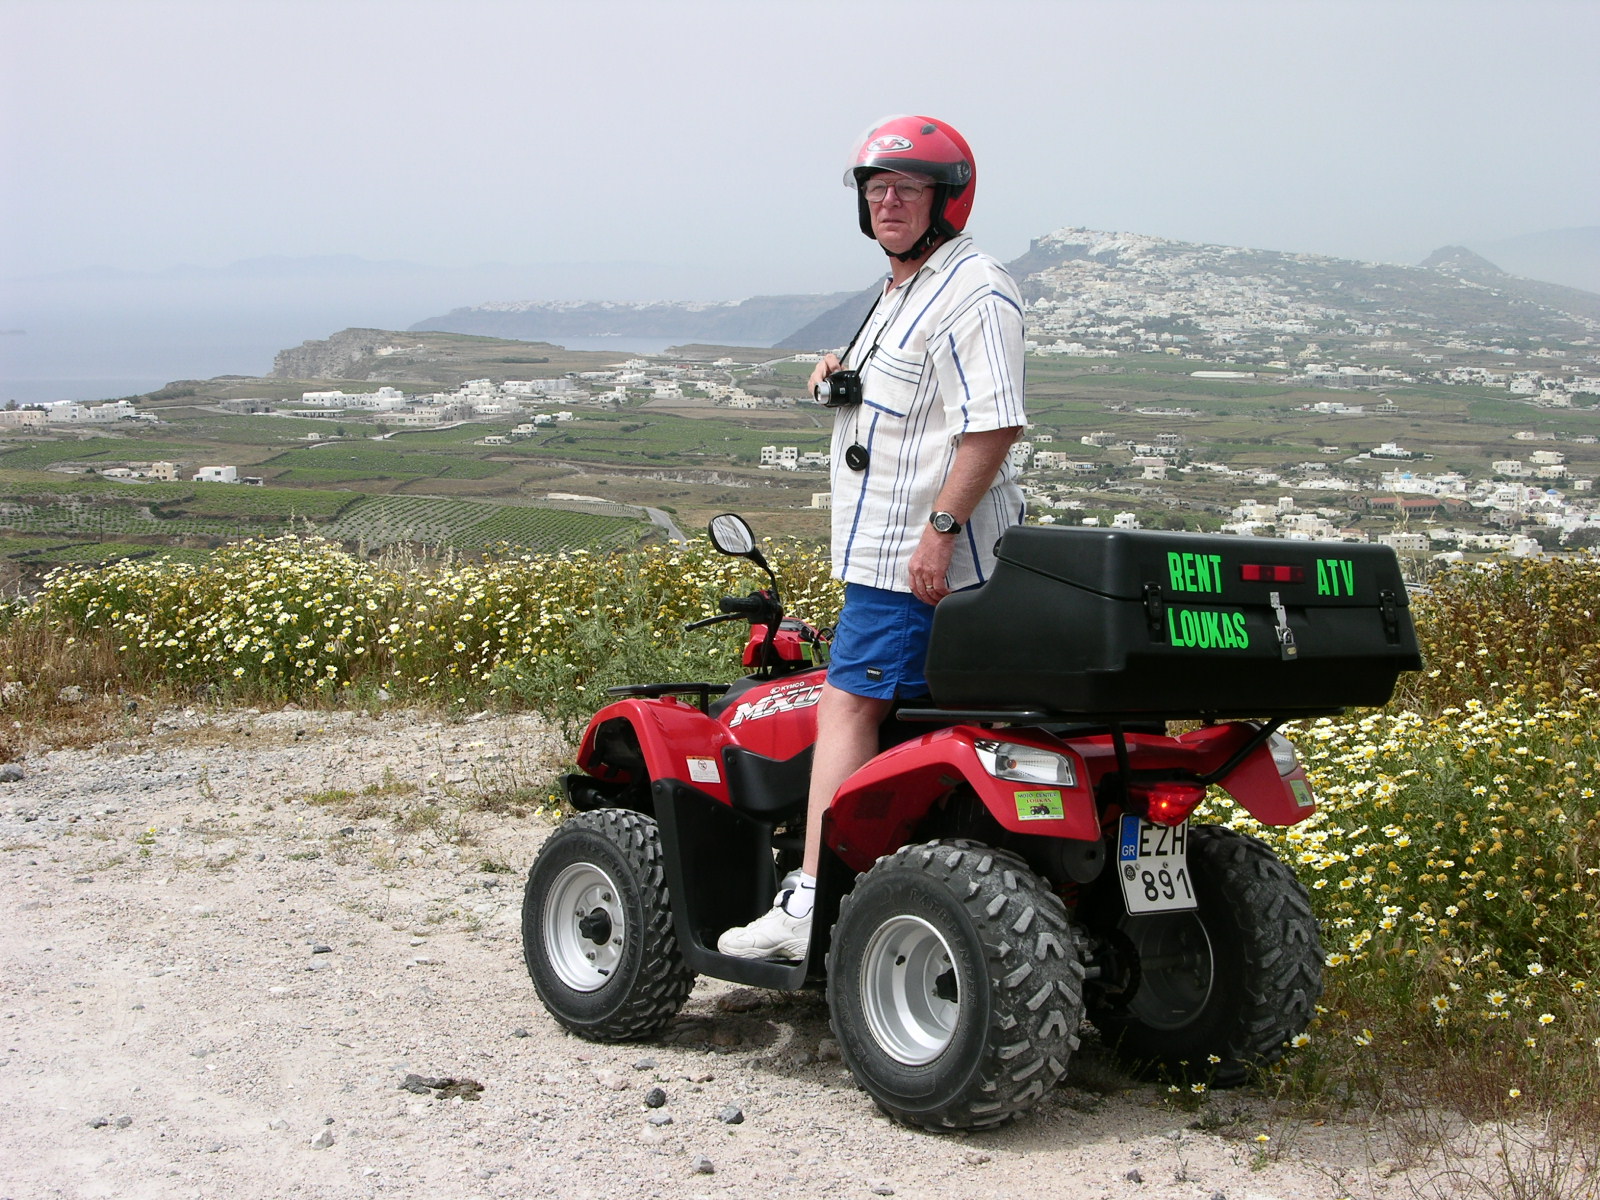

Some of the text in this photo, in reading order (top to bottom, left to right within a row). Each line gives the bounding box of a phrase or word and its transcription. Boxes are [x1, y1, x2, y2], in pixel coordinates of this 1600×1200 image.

[1167, 552, 1354, 597] RENT ATV
[1167, 607, 1249, 649] LOUKAS
[781, 681, 805, 691] KYMCO
[729, 684, 824, 728] MXU
[1121, 845, 1136, 857] GR
[1139, 823, 1186, 857] EZH
[1141, 868, 1192, 902] 891
